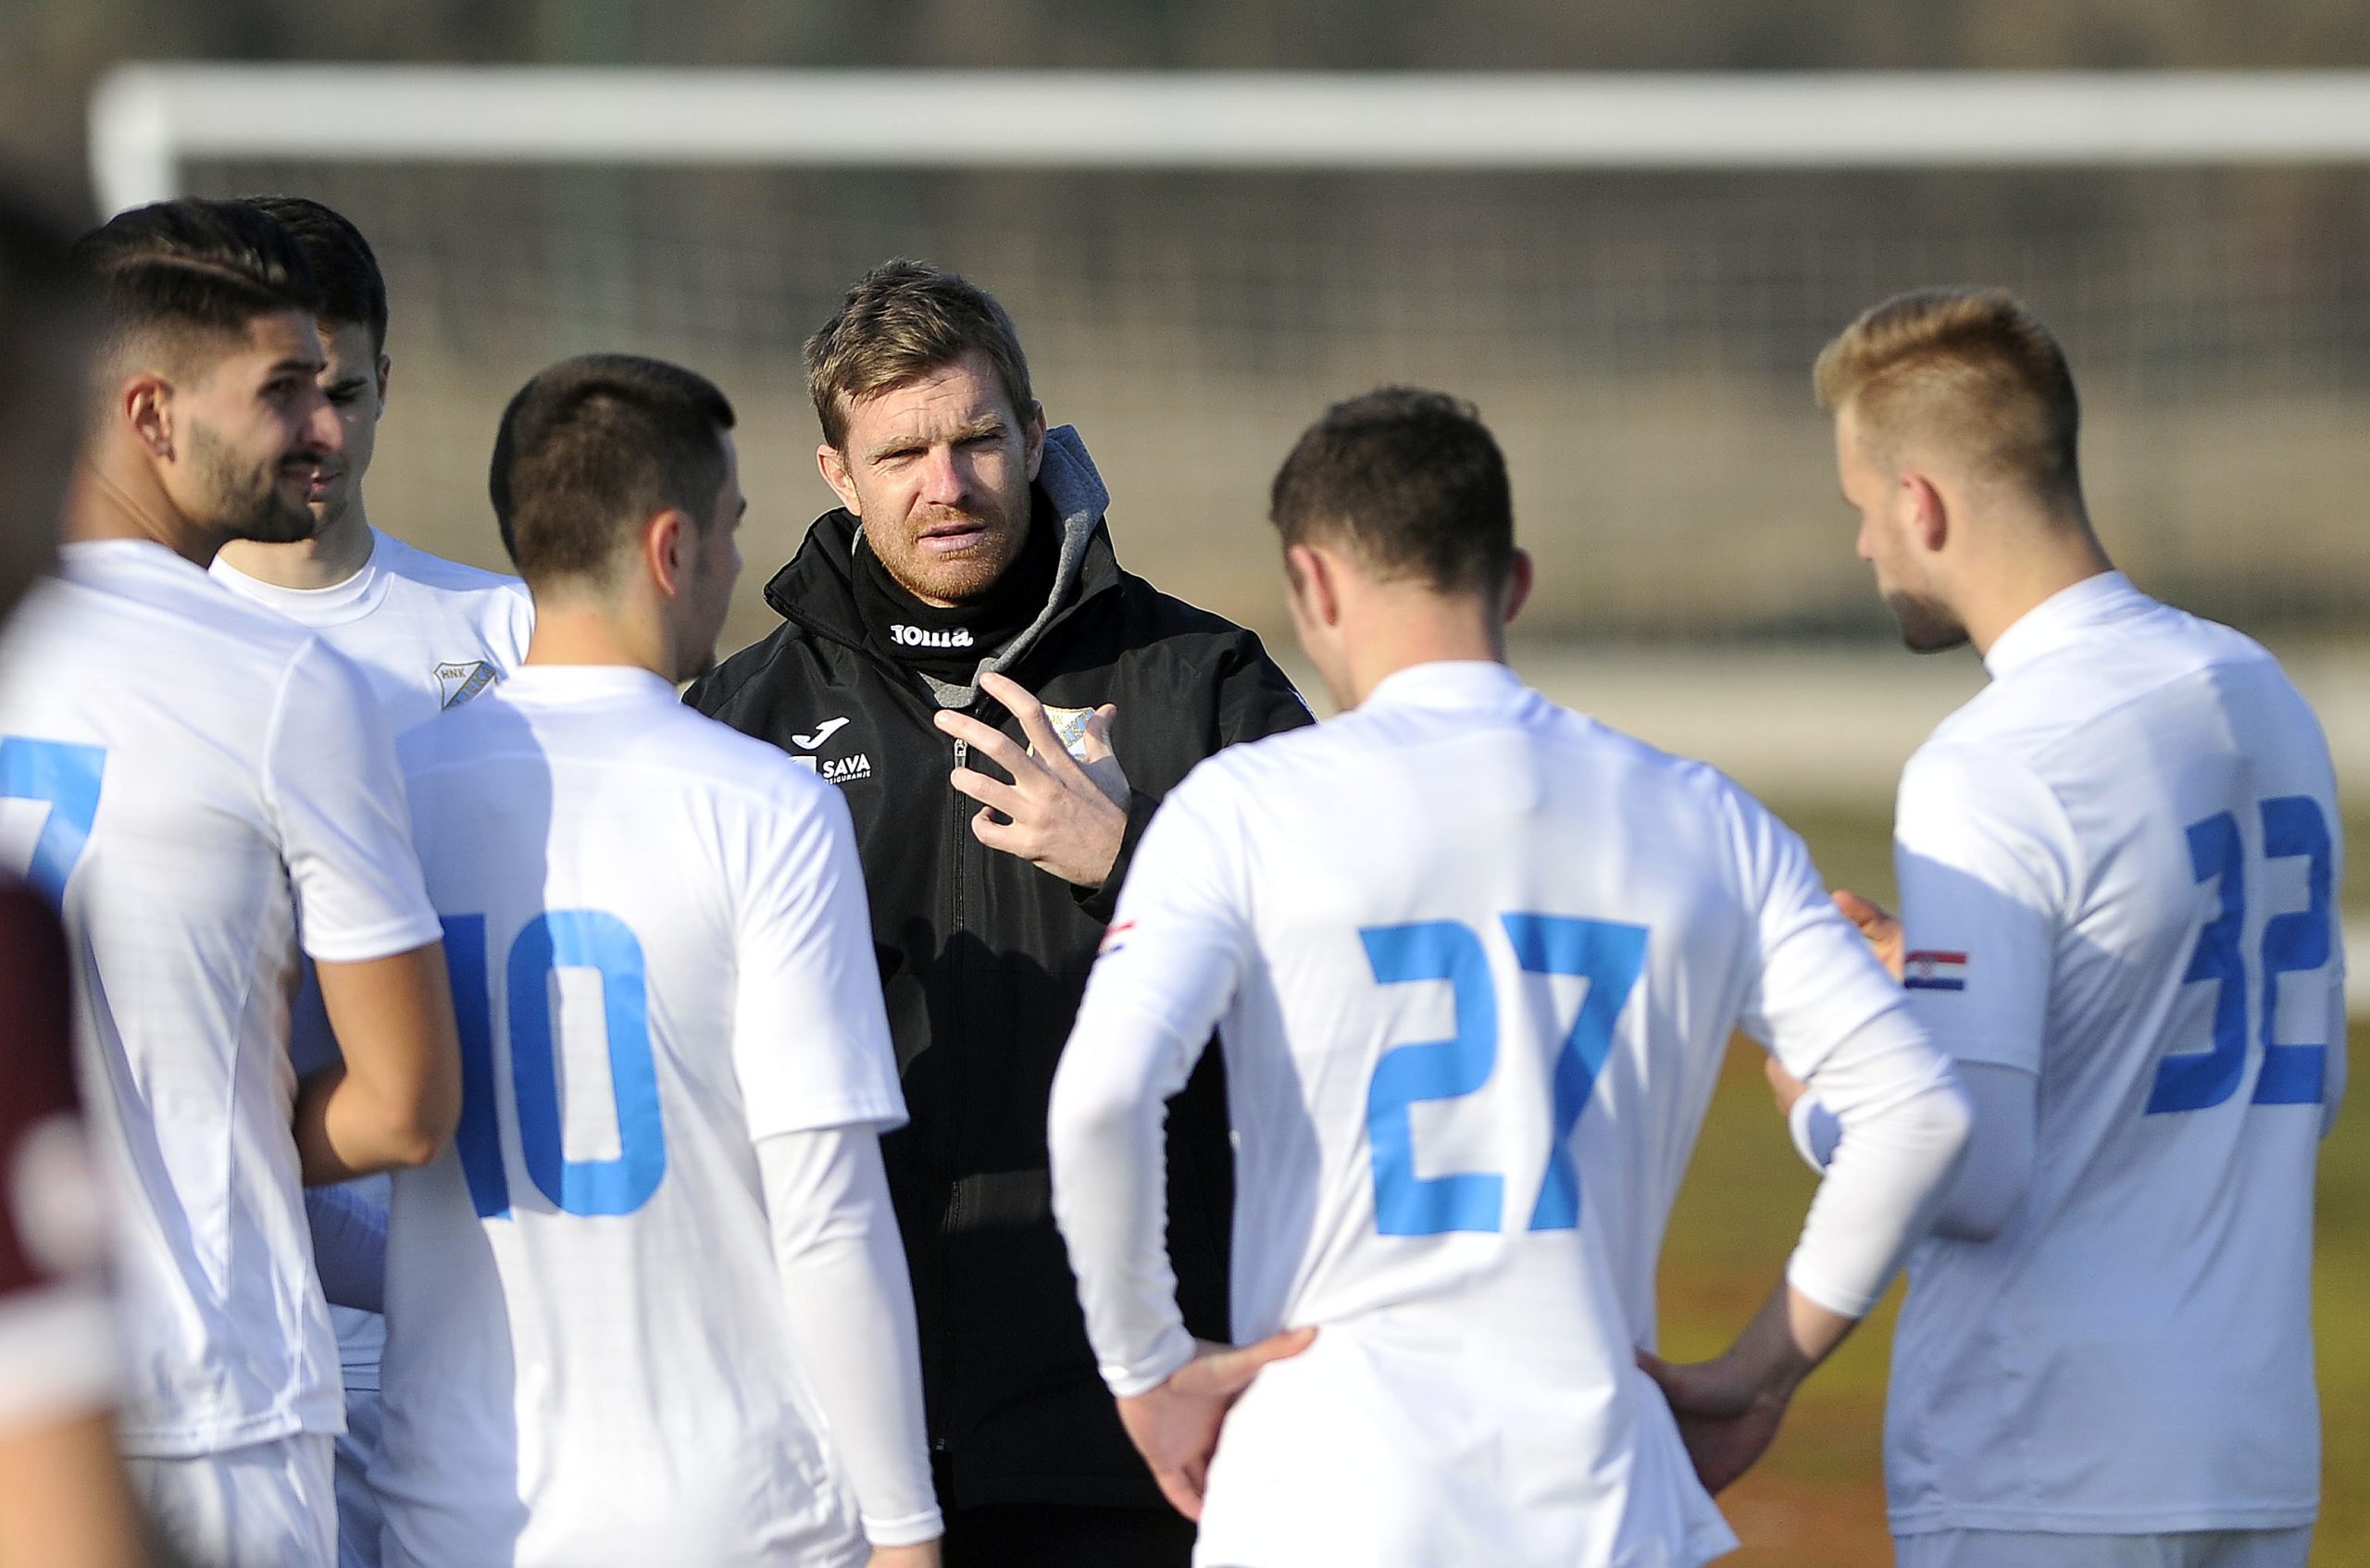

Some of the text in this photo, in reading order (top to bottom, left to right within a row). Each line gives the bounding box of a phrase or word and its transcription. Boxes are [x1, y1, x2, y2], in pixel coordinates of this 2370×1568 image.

[441, 668, 467, 678] HNK
[823, 753, 871, 778] SAVA
[440, 909, 667, 1221] 10
[1359, 912, 1650, 1236] 27
[2142, 795, 2333, 1116] 32
